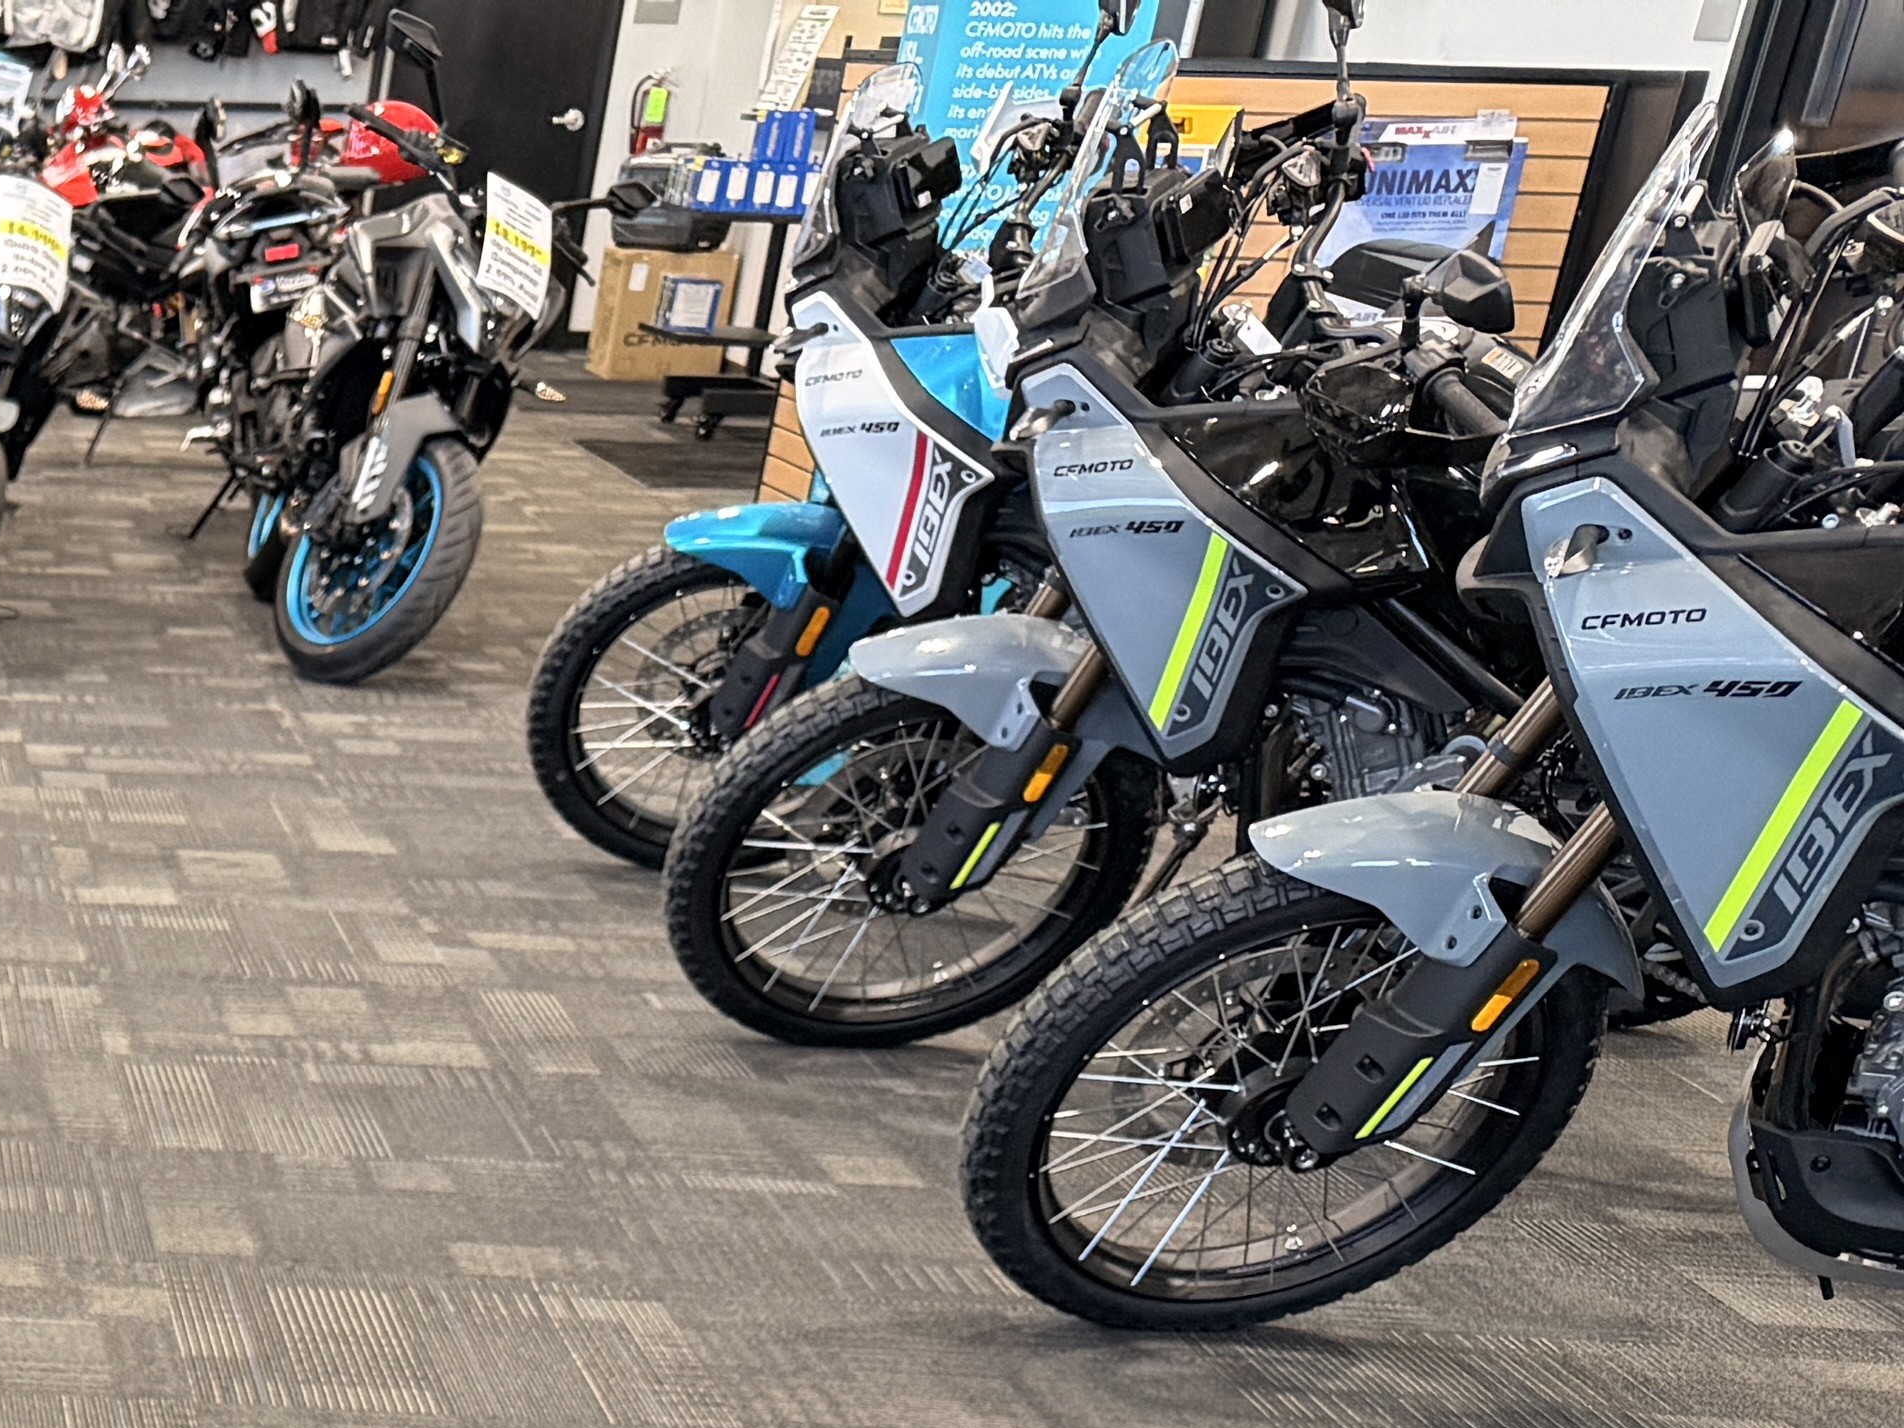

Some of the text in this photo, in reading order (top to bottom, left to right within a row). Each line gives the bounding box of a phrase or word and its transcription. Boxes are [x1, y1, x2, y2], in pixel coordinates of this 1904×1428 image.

[969, 1, 1018, 17] 2002:
[964, 21, 1092, 40] CFMOTO hits the
[960, 42, 1025, 59] off-road
[1025, 47, 1068, 60] scene
[955, 63, 974, 79] its
[975, 62, 1020, 80] debut
[1020, 63, 1058, 80] ATVs
[947, 104, 966, 119] its
[804, 369, 863, 387] CFMOTO
[859, 421, 900, 434] 450
[1053, 459, 1134, 478] CFMOTO
[912, 446, 953, 567] IBEX
[1069, 520, 1185, 538] IBEX 450
[1581, 608, 1708, 630] CFMOTO
[1192, 557, 1254, 701] IBEX
[1613, 680, 1804, 700] IBEX 450
[1773, 729, 1893, 915] IBEX
